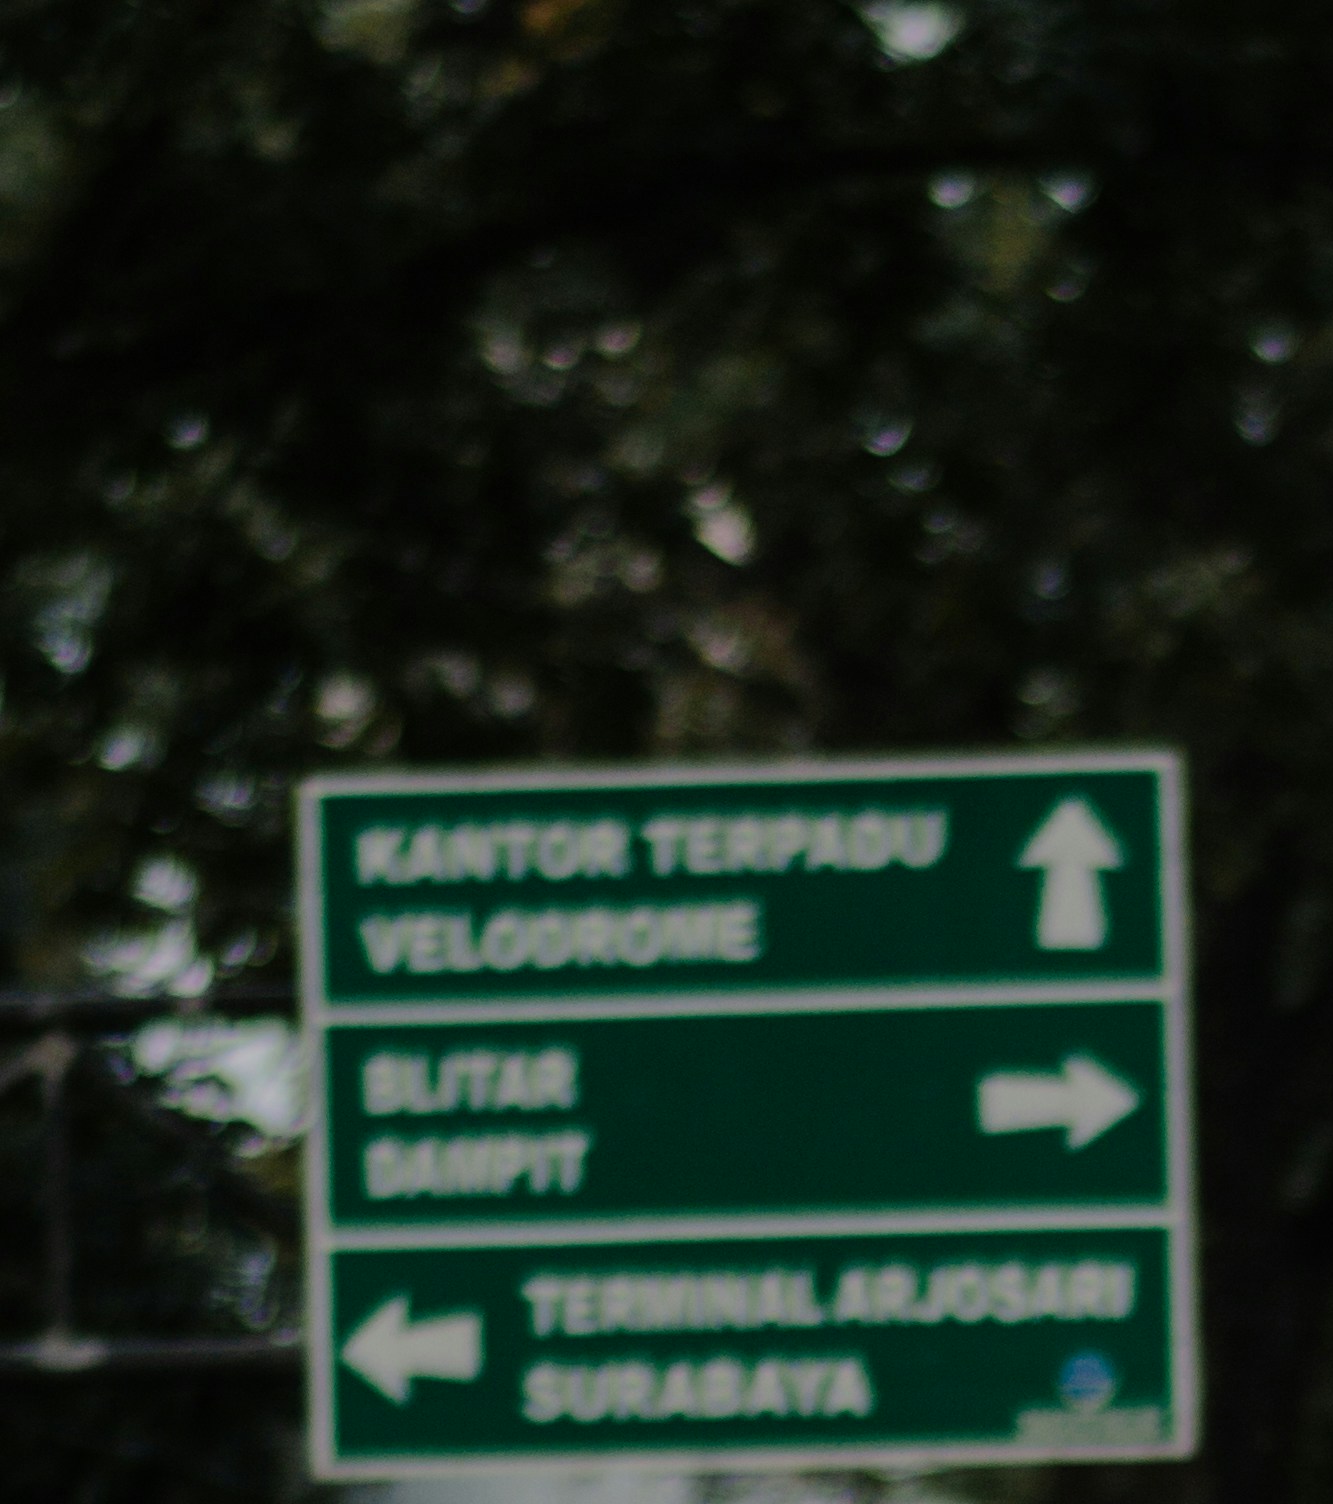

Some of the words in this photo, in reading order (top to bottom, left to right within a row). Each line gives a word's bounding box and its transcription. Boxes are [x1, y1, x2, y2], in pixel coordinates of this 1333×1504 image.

[356, 819, 631, 885] KANTOR
[640, 811, 948, 877] TERPADU
[359, 902, 762, 973] VELODROME
[363, 1049, 579, 1116] BLITAR
[364, 1130, 590, 1199] DAMPIT
[522, 1268, 822, 1337] TERMINAL
[833, 1261, 1135, 1325] ARJOSARI
[523, 1358, 872, 1423] SURABAYA
